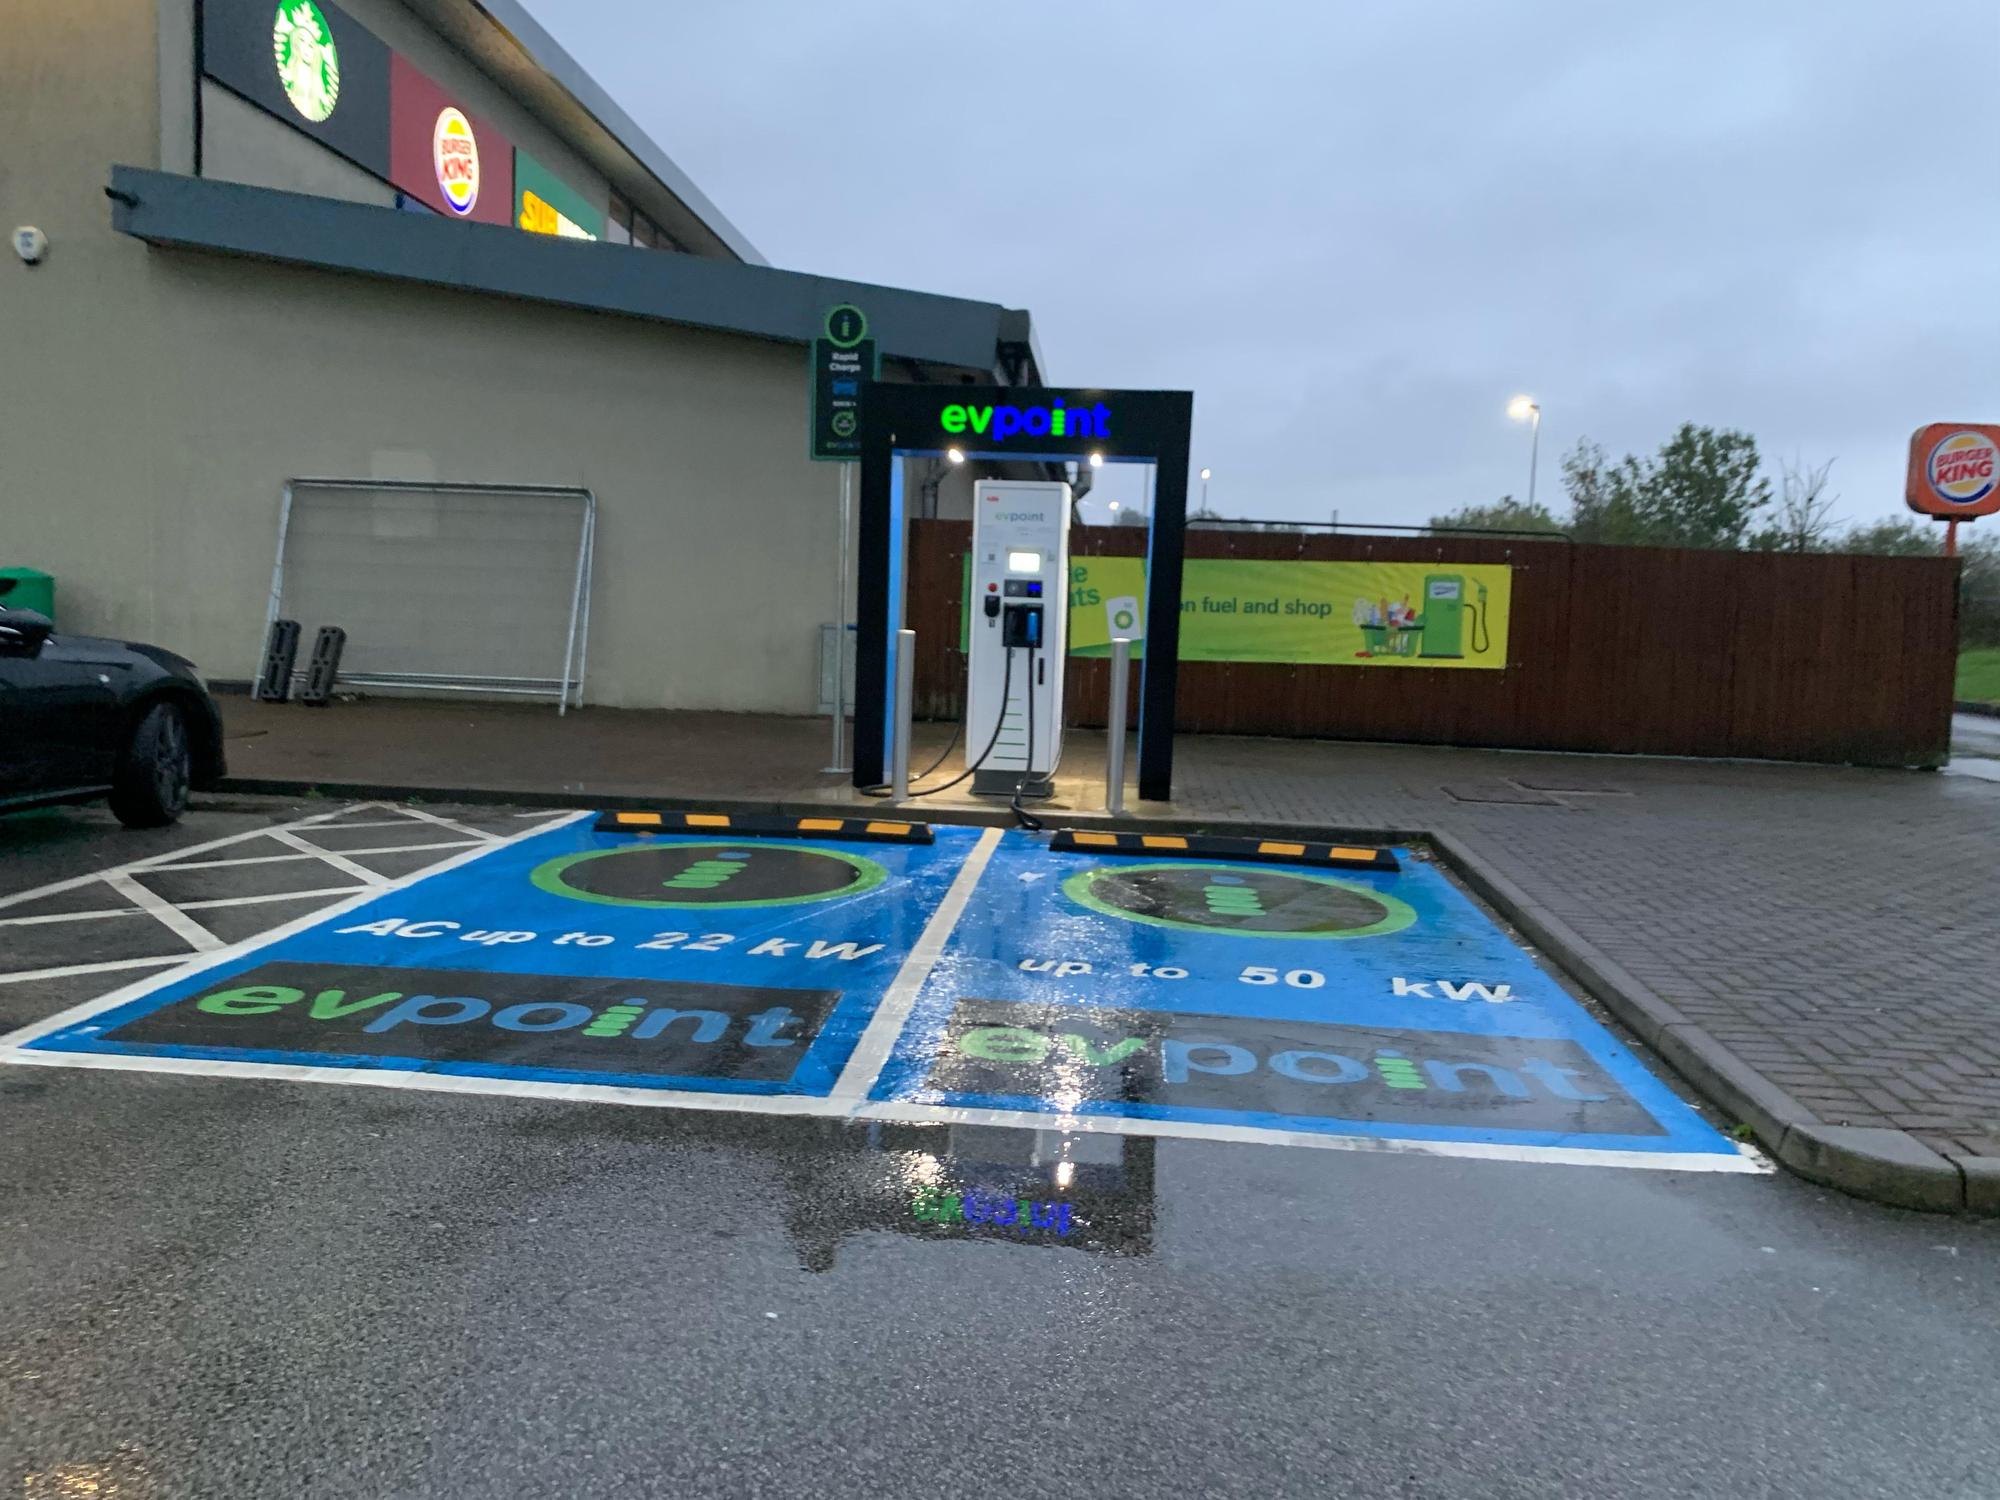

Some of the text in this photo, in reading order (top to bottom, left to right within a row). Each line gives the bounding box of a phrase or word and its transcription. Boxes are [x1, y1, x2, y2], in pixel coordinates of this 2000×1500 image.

[442, 157, 473, 182] KING
[940, 397, 1112, 440] evpoint
[1935, 460, 1994, 485] KING
[1202, 597, 1237, 613] fuel
[1243, 599, 1279, 614] and
[1284, 599, 1332, 618] shop
[334, 918, 461, 938] AC
[459, 928, 537, 946] up
[552, 931, 615, 947] to
[635, 932, 736, 951] 22
[1018, 958, 1512, 1003] up to 50 kW
[196, 986, 804, 1047] evpoint
[960, 1027, 1608, 1100] evpoint
